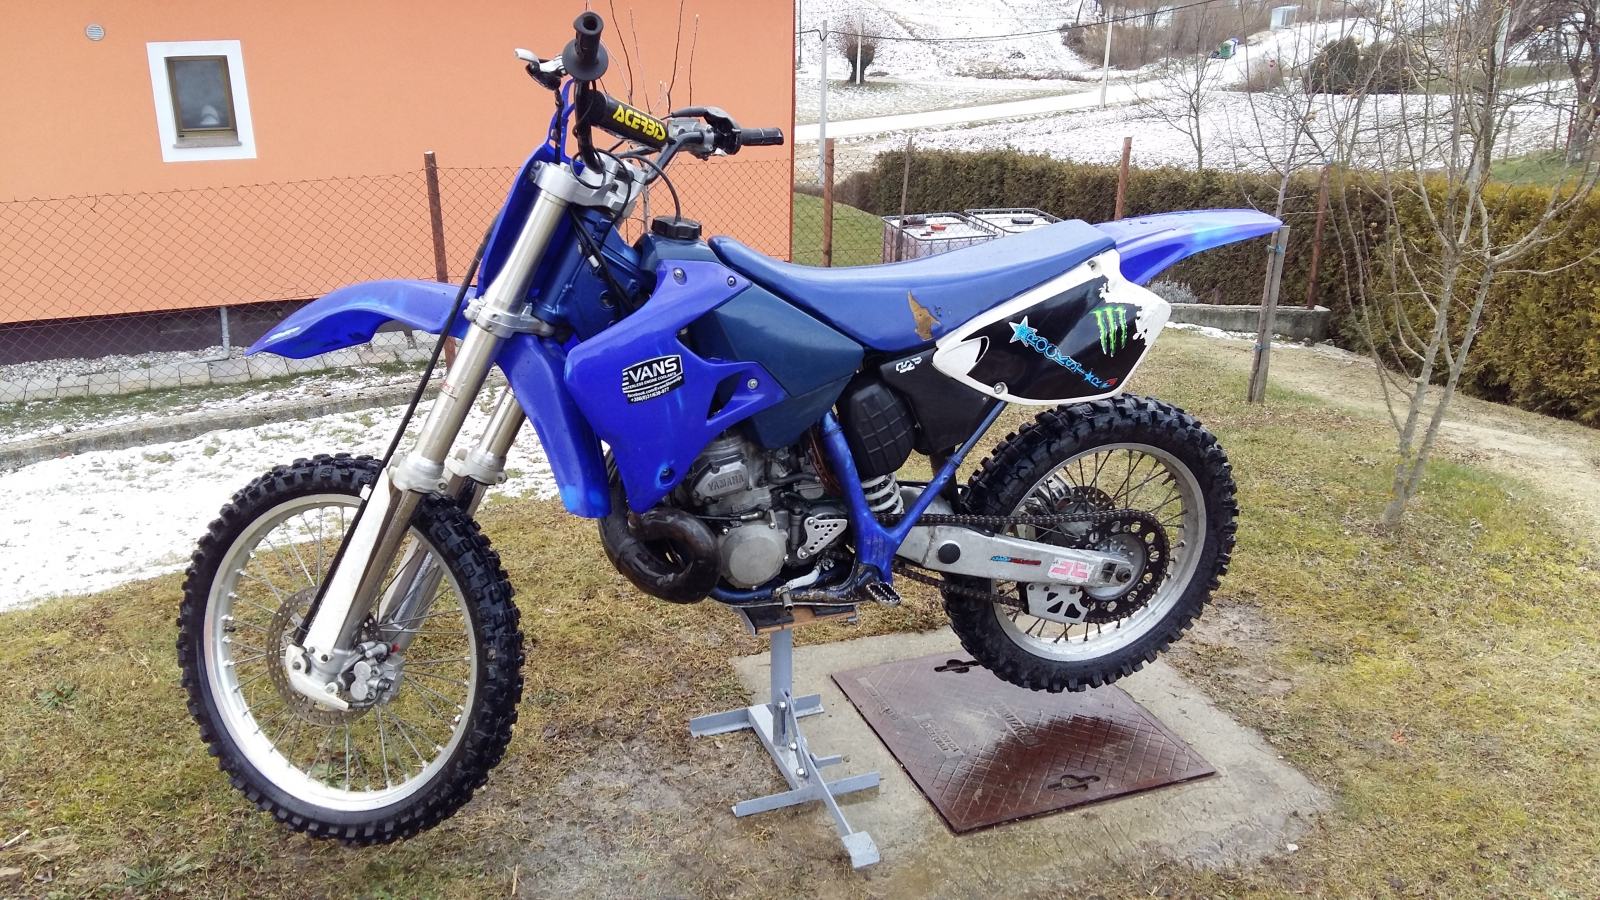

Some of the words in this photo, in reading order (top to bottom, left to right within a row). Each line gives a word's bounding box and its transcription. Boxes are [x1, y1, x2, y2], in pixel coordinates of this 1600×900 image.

[612, 104, 666, 140] ACERBIS
[658, 371, 677, 381] COOLANTS
[708, 474, 744, 491] YAMAHA
